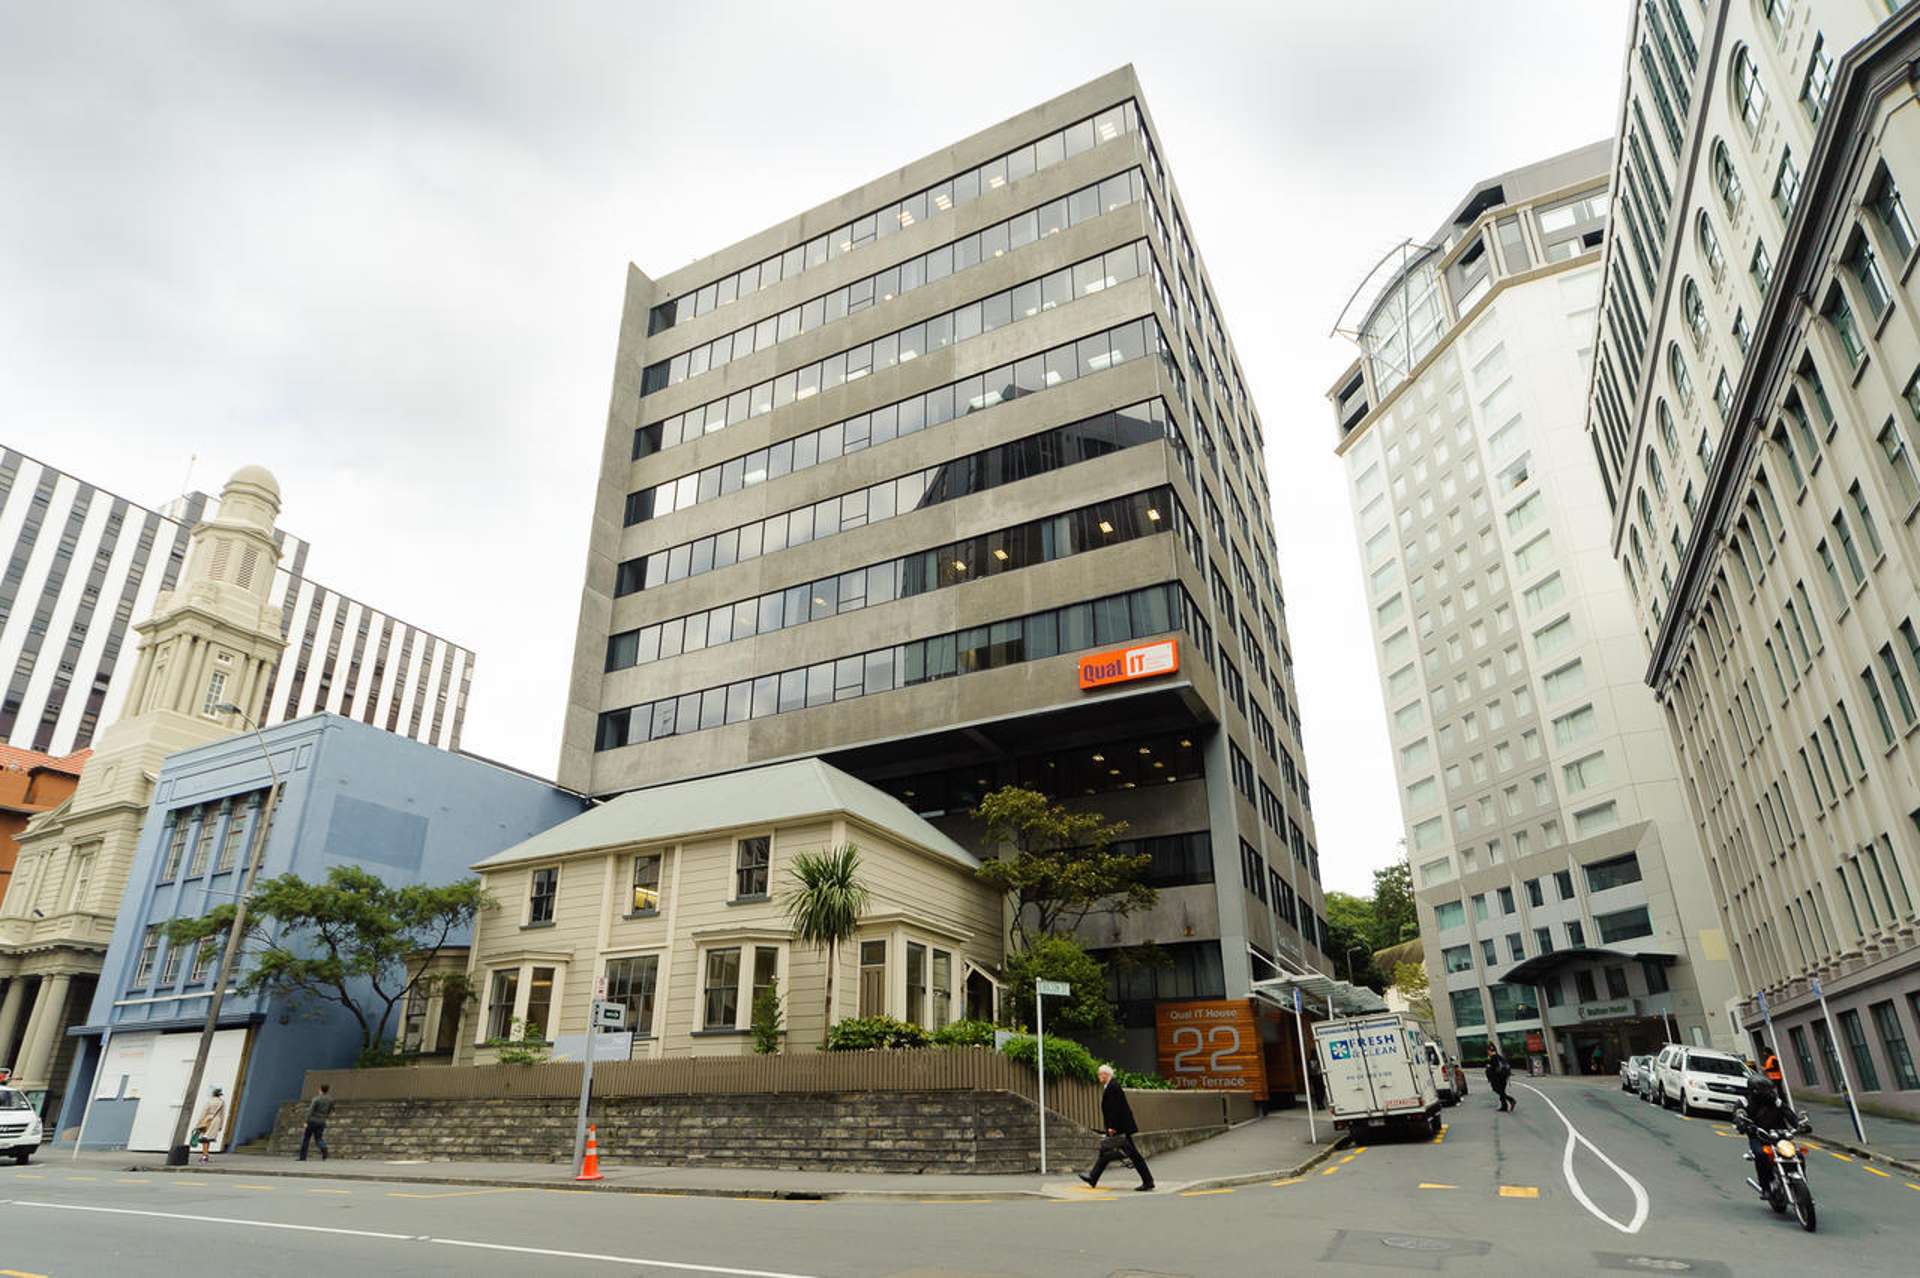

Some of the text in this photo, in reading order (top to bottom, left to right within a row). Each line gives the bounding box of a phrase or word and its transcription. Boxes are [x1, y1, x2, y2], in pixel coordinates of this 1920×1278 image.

[1084, 660, 1122, 682] Qual
[1130, 655, 1144, 673] IT
[1169, 1009, 1192, 1020] Qual
[1206, 1008, 1237, 1018] House
[1349, 1033, 1394, 1048] FRESH
[1173, 1026, 1242, 1072] 22
[1361, 1046, 1397, 1058] CLEAN
[1175, 1075, 1246, 1088] The Terrace
